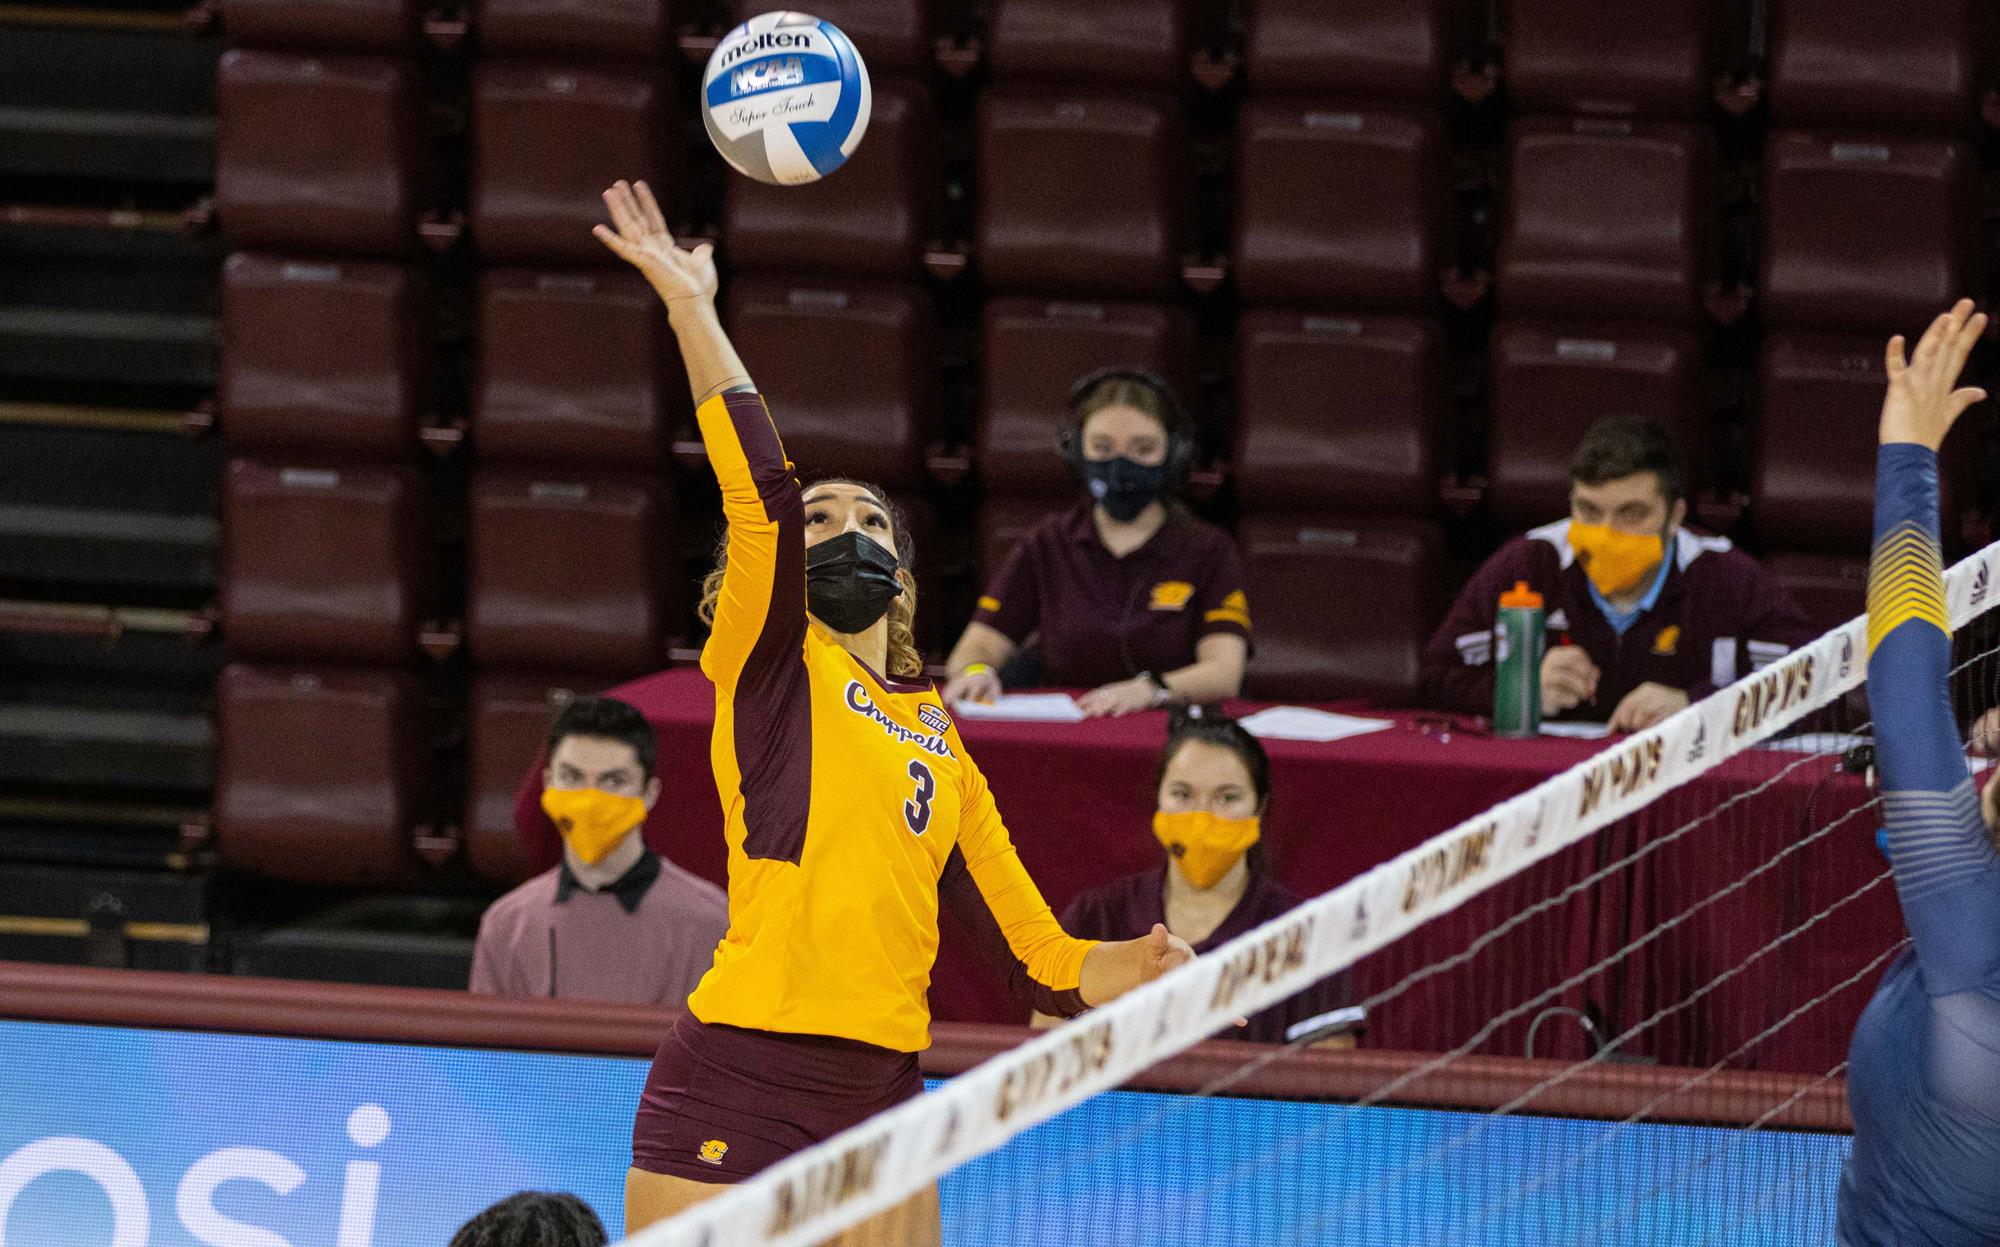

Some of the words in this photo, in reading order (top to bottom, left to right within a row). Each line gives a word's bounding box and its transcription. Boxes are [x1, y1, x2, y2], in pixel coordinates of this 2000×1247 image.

[721, 32, 811, 68] molten
[731, 57, 804, 97] NCAA
[730, 107, 767, 128] Super
[772, 93, 816, 116] Touch
[919, 711, 948, 733] MAC
[904, 758, 935, 837] 3
